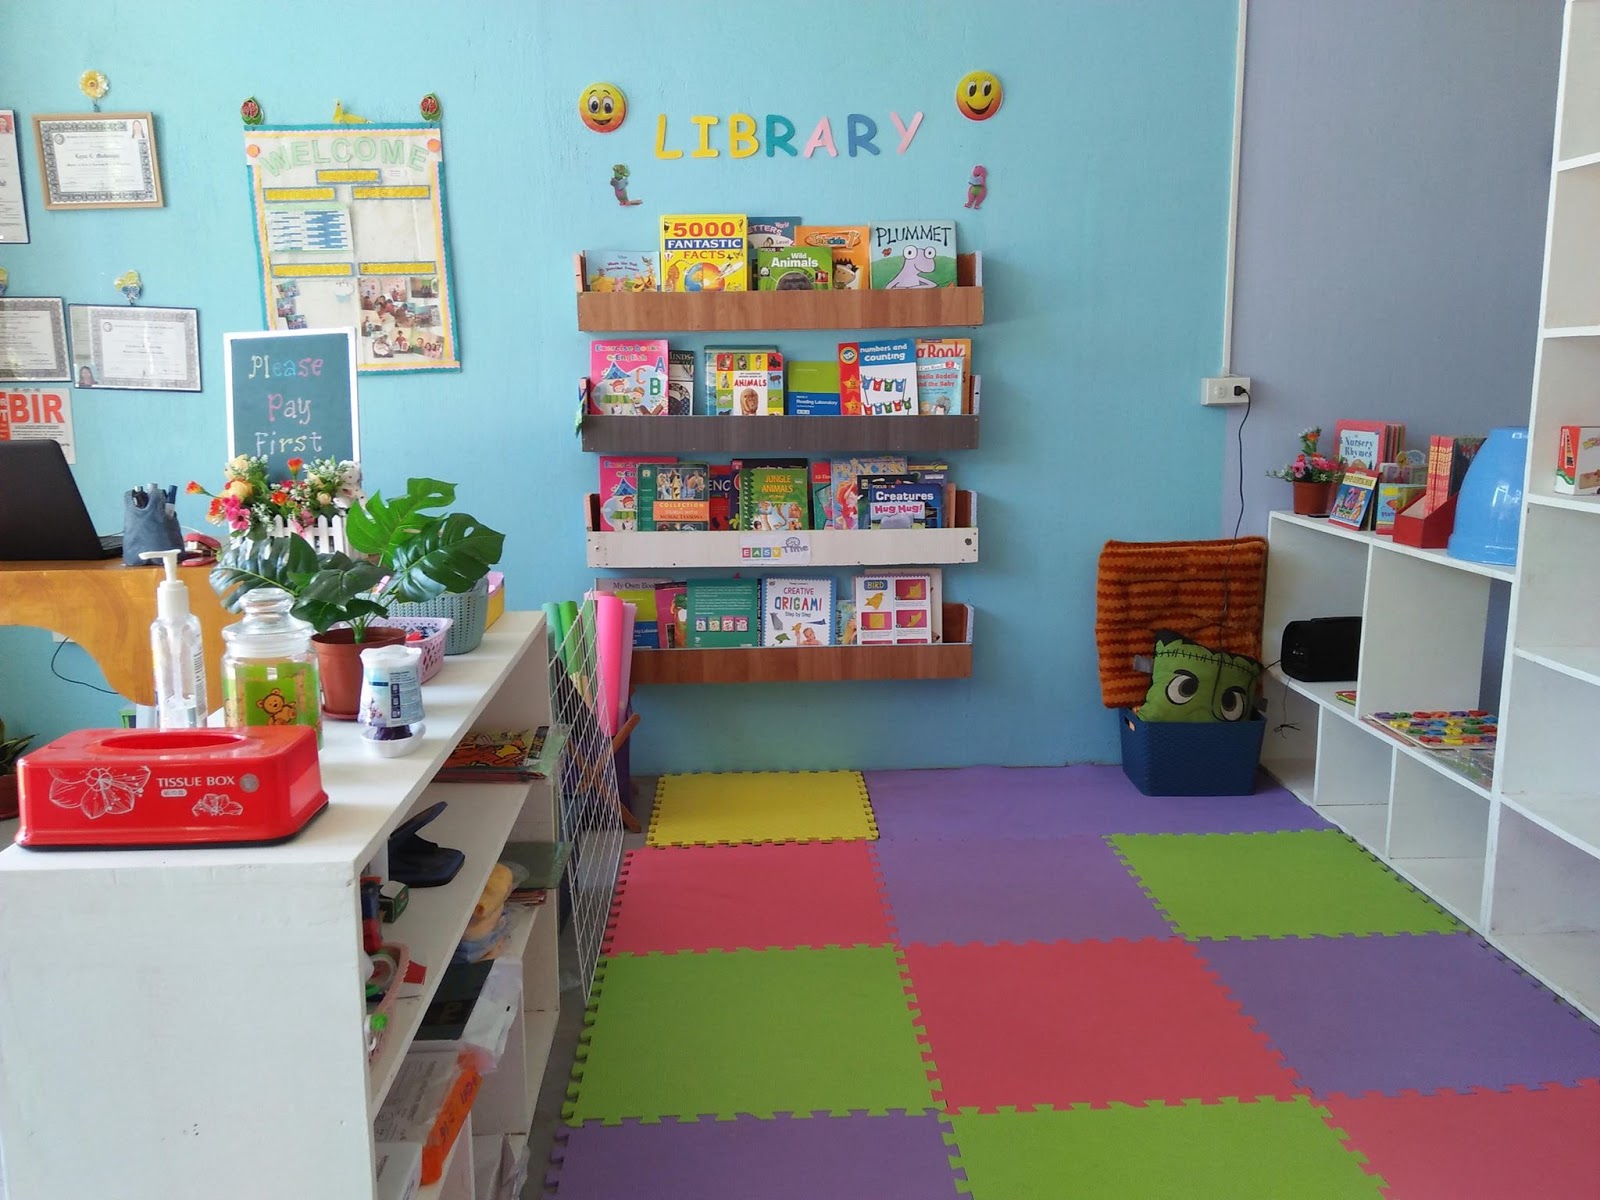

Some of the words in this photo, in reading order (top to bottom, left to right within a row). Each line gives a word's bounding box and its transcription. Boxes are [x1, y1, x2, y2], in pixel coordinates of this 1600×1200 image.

[655, 112, 925, 160] LIBRARY
[260, 137, 430, 178] WELCOME
[673, 222, 736, 238] 5000
[876, 225, 952, 247] PLUMMET
[667, 238, 742, 249] FANTASTIC
[683, 250, 726, 259] FACTS
[771, 259, 819, 269] Animals
[860, 345, 891, 353] numbers
[864, 352, 906, 363] counting
[248, 354, 324, 379] Please
[655, 356, 666, 373] A
[650, 377, 661, 396] B
[734, 379, 767, 387] ANIMALS
[8, 393, 66, 424] BIR
[267, 393, 312, 425] Pay
[255, 431, 322, 457] First
[1345, 437, 1373, 449] Nursery
[1344, 447, 1372, 458] Rhymes
[764, 475, 791, 483] JUNGLE
[762, 485, 794, 493] ANIMALS
[876, 491, 934, 500] Creatures
[874, 505, 896, 514] Hug
[898, 505, 923, 514] Hug!
[742, 547, 782, 558] EASY
[613, 582, 624, 590] My
[784, 587, 814, 595] CREATIVE
[867, 581, 885, 590] BIRD
[775, 597, 822, 611] ORIGAMI
[157, 777, 202, 788] TISSUE
[206, 776, 236, 786] BOX
